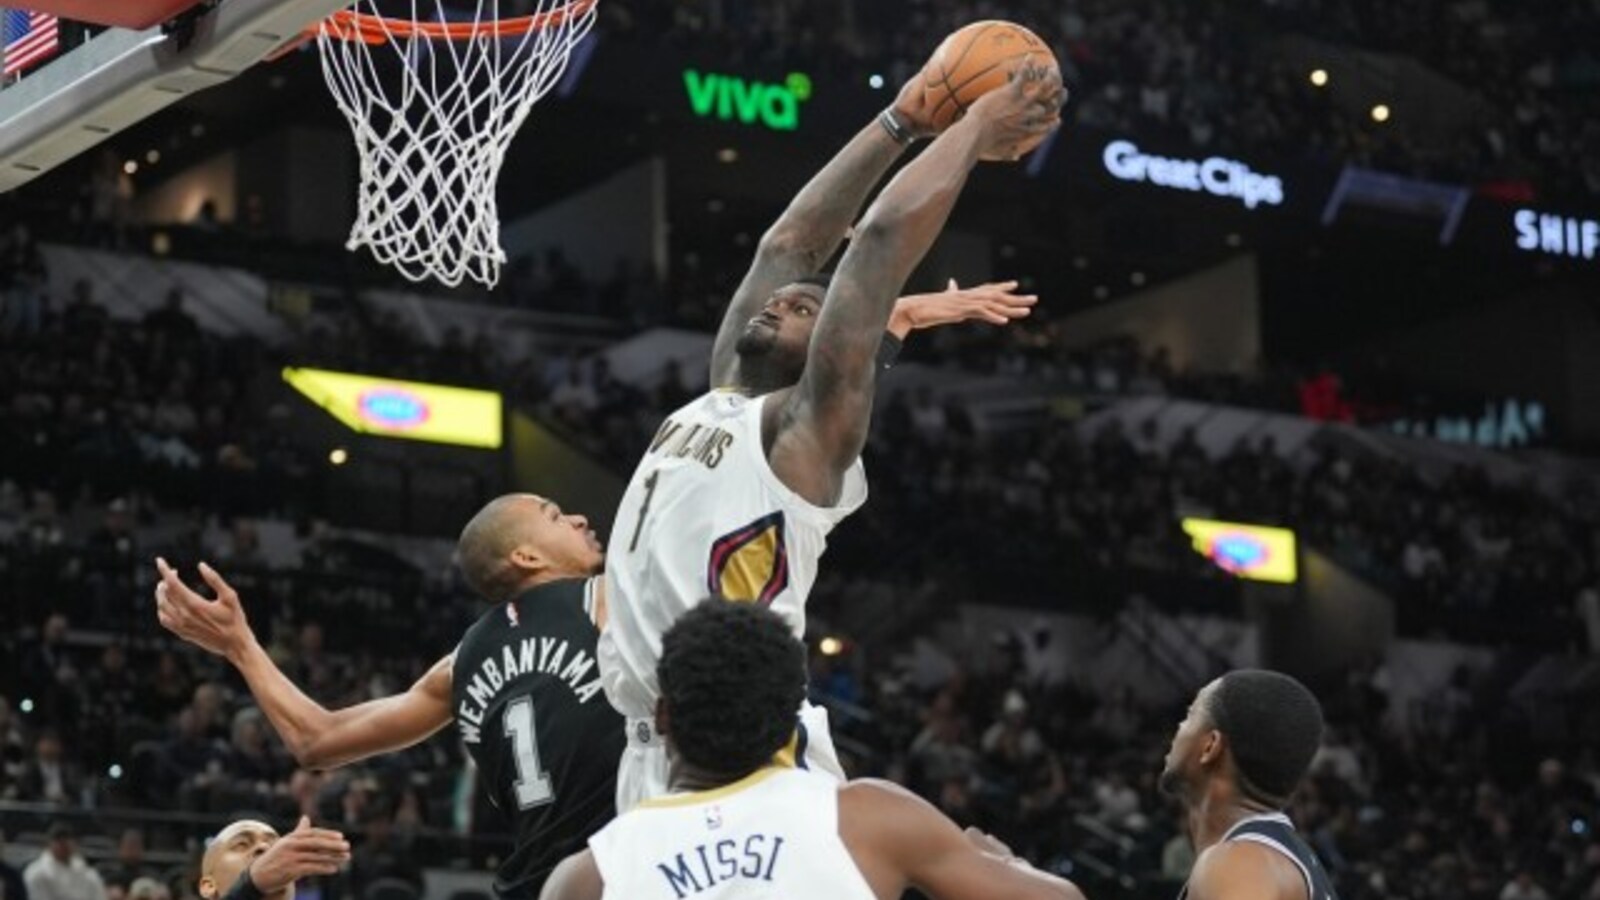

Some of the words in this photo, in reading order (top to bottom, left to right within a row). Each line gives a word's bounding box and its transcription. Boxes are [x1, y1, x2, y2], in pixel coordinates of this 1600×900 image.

[1514, 208, 1600, 259] SHIF
[629, 469, 659, 552] 1
[457, 636, 603, 744] WEMBANYAMA
[502, 694, 556, 811] 1
[657, 834, 784, 899] MISSI
